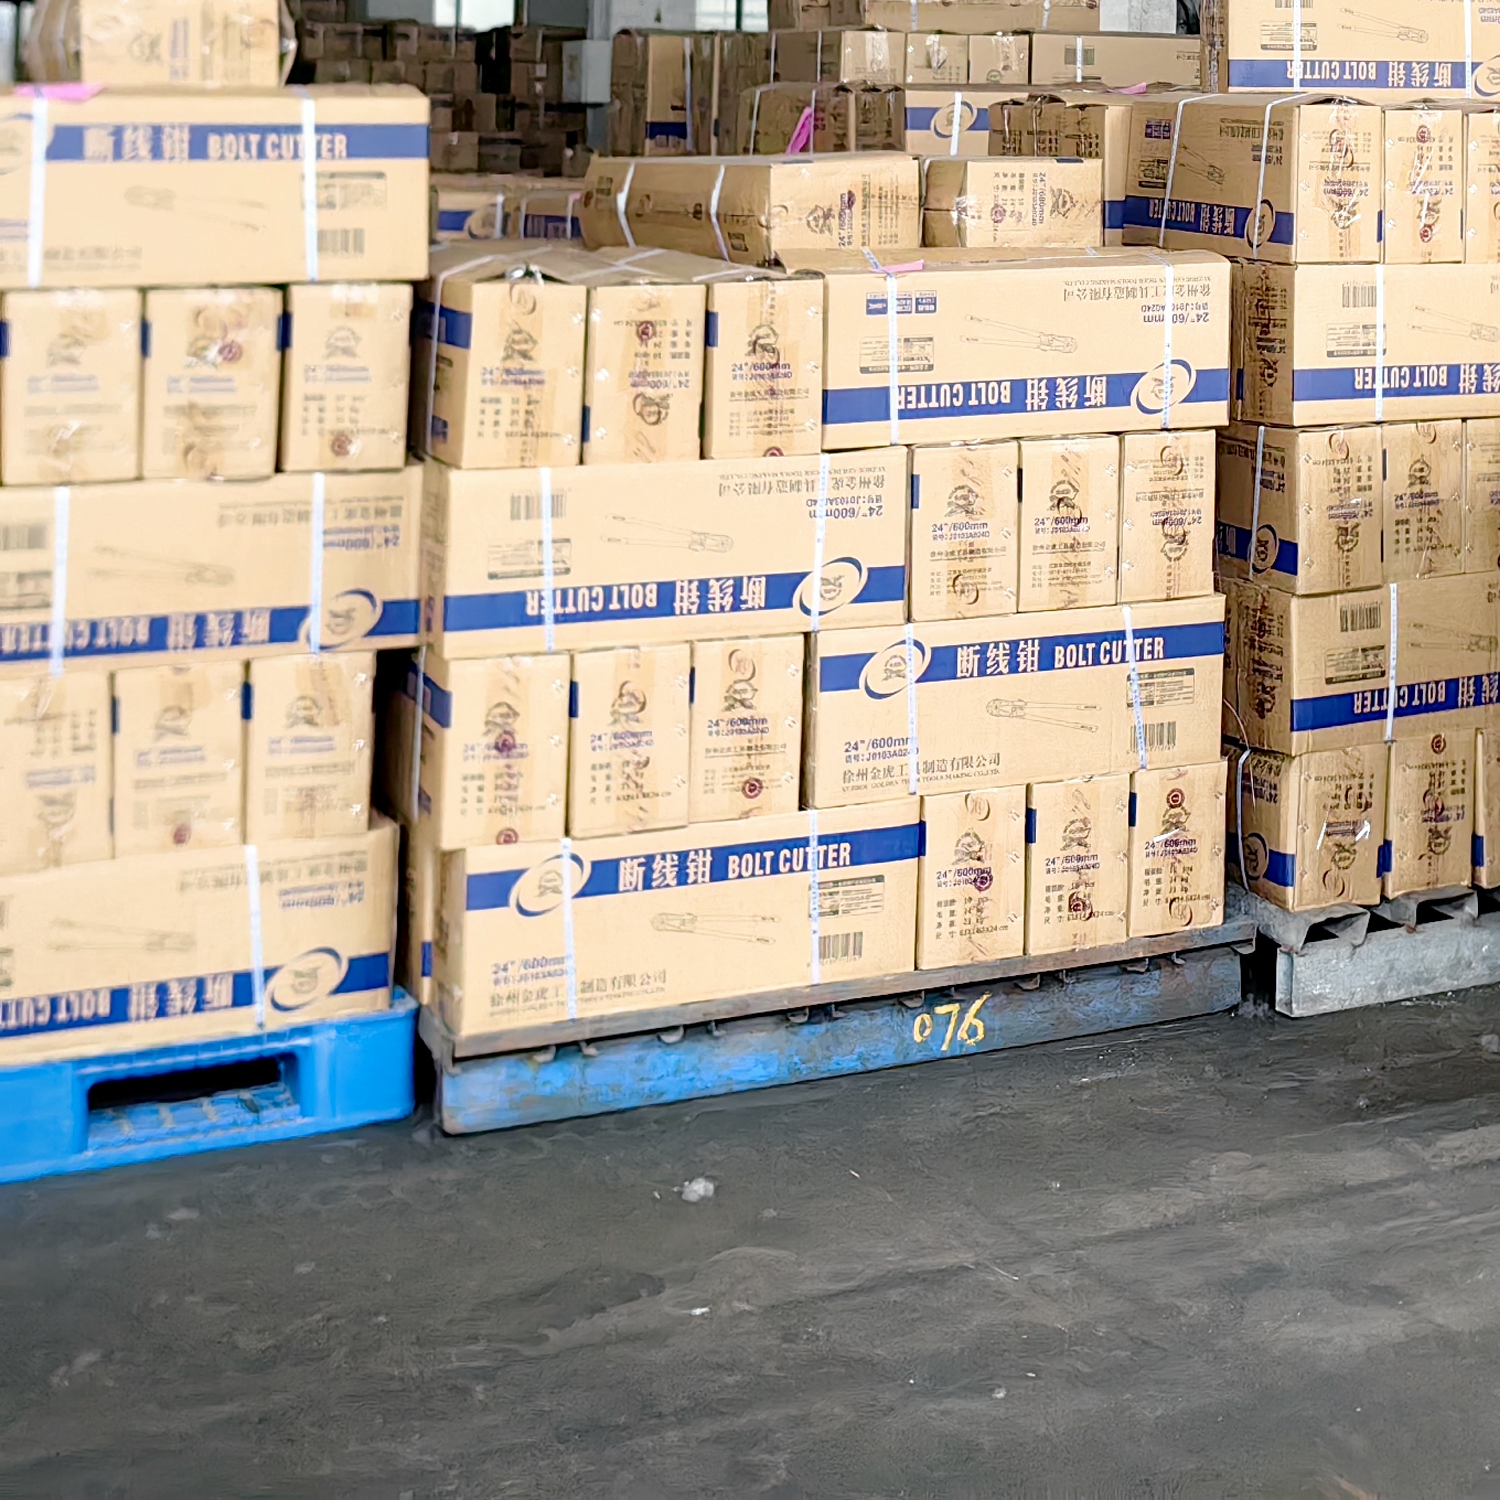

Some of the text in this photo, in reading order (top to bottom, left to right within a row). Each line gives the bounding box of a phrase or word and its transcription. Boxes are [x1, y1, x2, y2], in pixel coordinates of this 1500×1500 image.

[1344, 61, 1378, 81] BOLT
[1386, 61, 1453, 88] 断线钳
[206, 133, 261, 160] BOLT
[1413, 366, 1448, 389] BOLT
[967, 381, 1011, 407] BOLT
[1026, 375, 1107, 411] 断线钳
[608, 583, 658, 610] BOLT
[672, 575, 767, 615] 断线钳
[956, 639, 1041, 678] 断线钳
[1054, 643, 1096, 669] BOLT
[1412, 681, 1446, 706] BOLT
[842, 752, 1001, 784] 徐州金虎工制造有限公司
[618, 849, 713, 893] 断线钳
[727, 851, 775, 879] BOLT
[913, 991, 992, 1051] 076
